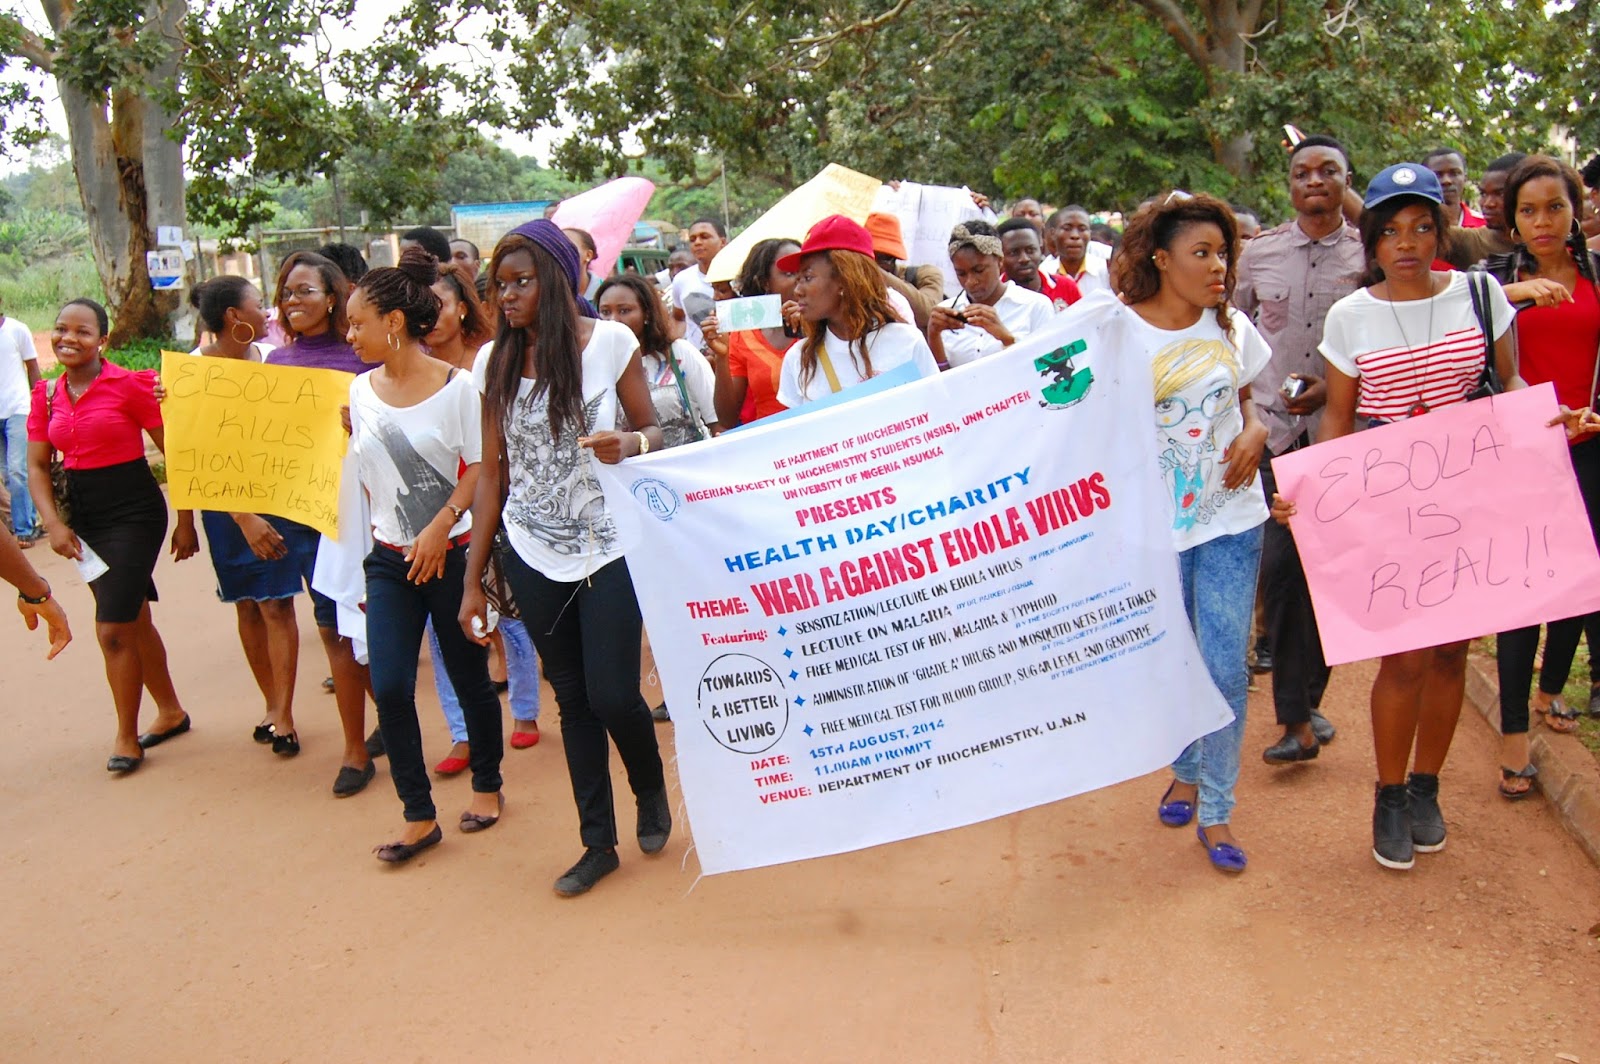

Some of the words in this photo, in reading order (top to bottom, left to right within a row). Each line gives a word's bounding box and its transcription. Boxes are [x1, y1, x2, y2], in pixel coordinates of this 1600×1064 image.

[173, 362, 320, 409] EBOLA
[217, 409, 314, 449] KILLS
[685, 484, 734, 503] NIGERIAN
[734, 477, 776, 493] SOCIETY
[779, 474, 790, 486] OF
[795, 452, 868, 481] BIOCHEMISTRY
[870, 433, 922, 462] STUDENTS
[962, 410, 984, 426] UNN
[985, 390, 1032, 417] CHAPTER
[842, 438, 855, 450] OF
[857, 412, 930, 446] BIOCHEMISTRY
[175, 448, 244, 473] JION
[251, 452, 300, 479] THE
[782, 476, 843, 500] UNIVERSITY
[845, 473, 858, 486] OF
[860, 460, 901, 480] NIGERIA
[902, 446, 944, 468] NSUKKA
[1315, 424, 1504, 523] EBOLA
[188, 477, 278, 501] AGAINST
[795, 486, 897, 528] PRESENTS
[724, 533, 838, 573] HEALTH
[846, 466, 1031, 546] DAY/CHARITY
[1407, 503, 1461, 540] IS
[686, 597, 749, 620] THEME:
[750, 572, 820, 618] WAR
[819, 537, 939, 604] AGAINST
[939, 506, 1030, 568] EBOLA
[1025, 471, 1112, 537] VIRUS
[931, 583, 949, 598] ON
[950, 570, 987, 592] EBOLA
[988, 557, 1023, 578] VIRUS
[1028, 615, 1040, 624] THE
[1042, 605, 1070, 619] SOCIETY
[1071, 600, 1084, 608] FOR
[1085, 591, 1108, 603] FAMILY
[1109, 614, 1129, 626] FAMILY
[701, 629, 768, 646] Featuring:
[801, 630, 863, 657] LECTURE
[867, 625, 888, 642] ON
[891, 605, 952, 632] MALARIA
[805, 662, 833, 679] FREE
[835, 650, 882, 672] MEDICAL
[885, 642, 909, 662] TEST
[912, 638, 925, 652] OF
[928, 627, 952, 648] HIV,
[953, 614, 998, 639] MALARIA
[1001, 611, 1009, 624] &
[1010, 593, 1058, 618] TYPHOID
[812, 676, 896, 706] ADMINISTRATION
[898, 669, 909, 685] OF
[962, 645, 995, 666] DRUGS
[997, 637, 1018, 656] AND
[1019, 622, 1072, 649] MOSQUITO
[1072, 611, 1097, 630] NETS
[1098, 604, 1118, 621] FOR
[1119, 600, 1126, 613] A
[1125, 588, 1157, 609] TOKEN
[703, 668, 772, 692] TOWARDS
[820, 719, 847, 735] FREE
[849, 709, 893, 730] MEDICAL
[894, 701, 918, 721] TEST
[920, 695, 941, 711] FOR
[942, 684, 977, 704] BLOOD
[978, 672, 1016, 693] GROUP,
[1017, 660, 1053, 681] SUGAR
[1053, 651, 1081, 670] LEVEL
[1084, 642, 1104, 658] AND
[1105, 624, 1152, 651] GENOTYPE
[1061, 668, 1074, 677] THE
[1076, 653, 1118, 672] DEPARTMENT
[711, 705, 721, 719] A
[724, 695, 779, 716] BETTER
[727, 721, 776, 744] LIVING
[751, 754, 791, 771] DATE:
[809, 743, 844, 760] 15TH
[848, 729, 911, 752] AUGUST,
[912, 718, 945, 736] 2014
[755, 772, 794, 788] TIME:
[814, 756, 871, 777] 11.00AM
[875, 740, 932, 762] PROMPT
[759, 786, 812, 805] VENUE:
[818, 764, 911, 794] DEPARTMENT
[915, 758, 933, 771] OF
[937, 726, 1043, 766] BIOCHEMISTRY,
